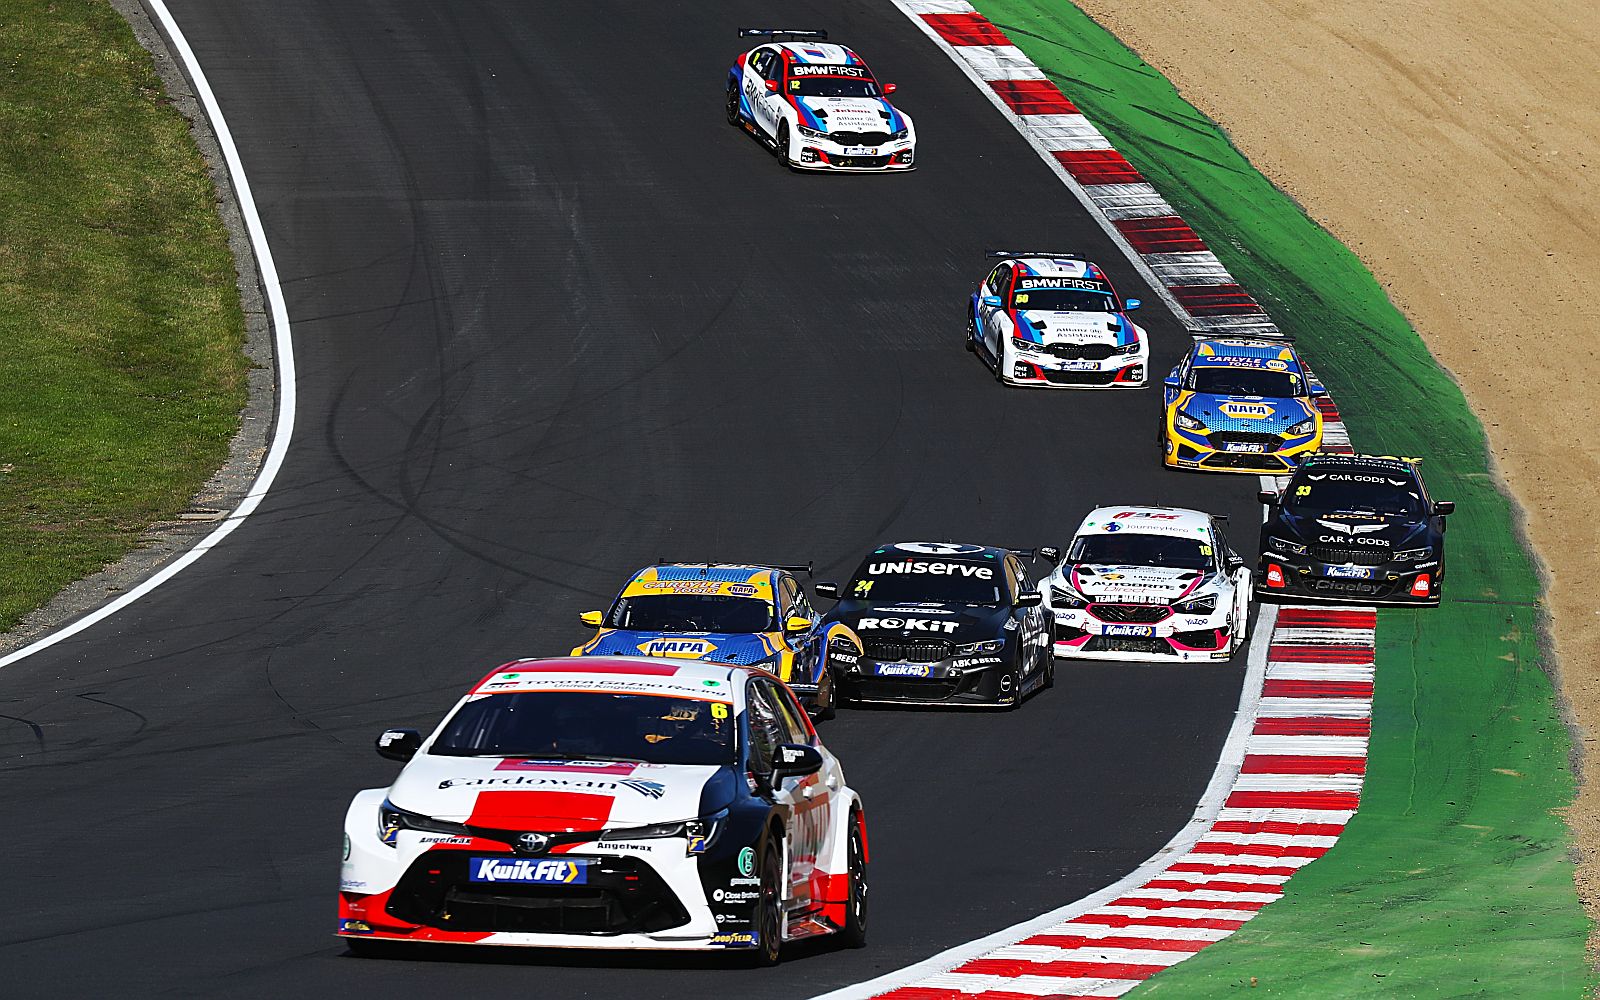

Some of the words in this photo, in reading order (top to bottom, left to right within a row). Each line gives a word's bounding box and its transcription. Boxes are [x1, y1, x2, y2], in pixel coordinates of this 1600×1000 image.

[793, 66, 864, 77] BMWFIRST
[790, 80, 800, 89] 12
[1021, 279, 1103, 290] BMWFIRST
[1016, 294, 1029, 303] 50
[1206, 356, 1262, 364] CARLYLE
[1228, 405, 1266, 414] NAPA
[1226, 444, 1260, 452] KwikFit
[1354, 475, 1385, 484] GODS
[1295, 486, 1311, 496] 33
[1319, 535, 1345, 543] CAR
[1356, 537, 1390, 546] GODS
[1199, 545, 1213, 556] 19
[643, 581, 722, 589] CARLYLE
[732, 586, 753, 594] NAPA
[854, 580, 874, 592] 24
[1104, 625, 1147, 636] KwikFit
[650, 642, 704, 653] NAPA
[835, 653, 858, 664] BEER
[952, 658, 972, 668] ABK
[980, 657, 1002, 665] BEER
[878, 664, 924, 677] KwikFit
[671, 685, 727, 697] Racing
[710, 702, 728, 719] 6
[438, 776, 618, 790] Cardowan
[419, 836, 472, 845] Angelwax
[596, 842, 652, 852] Angelwax
[477, 859, 568, 882] KwikFit
